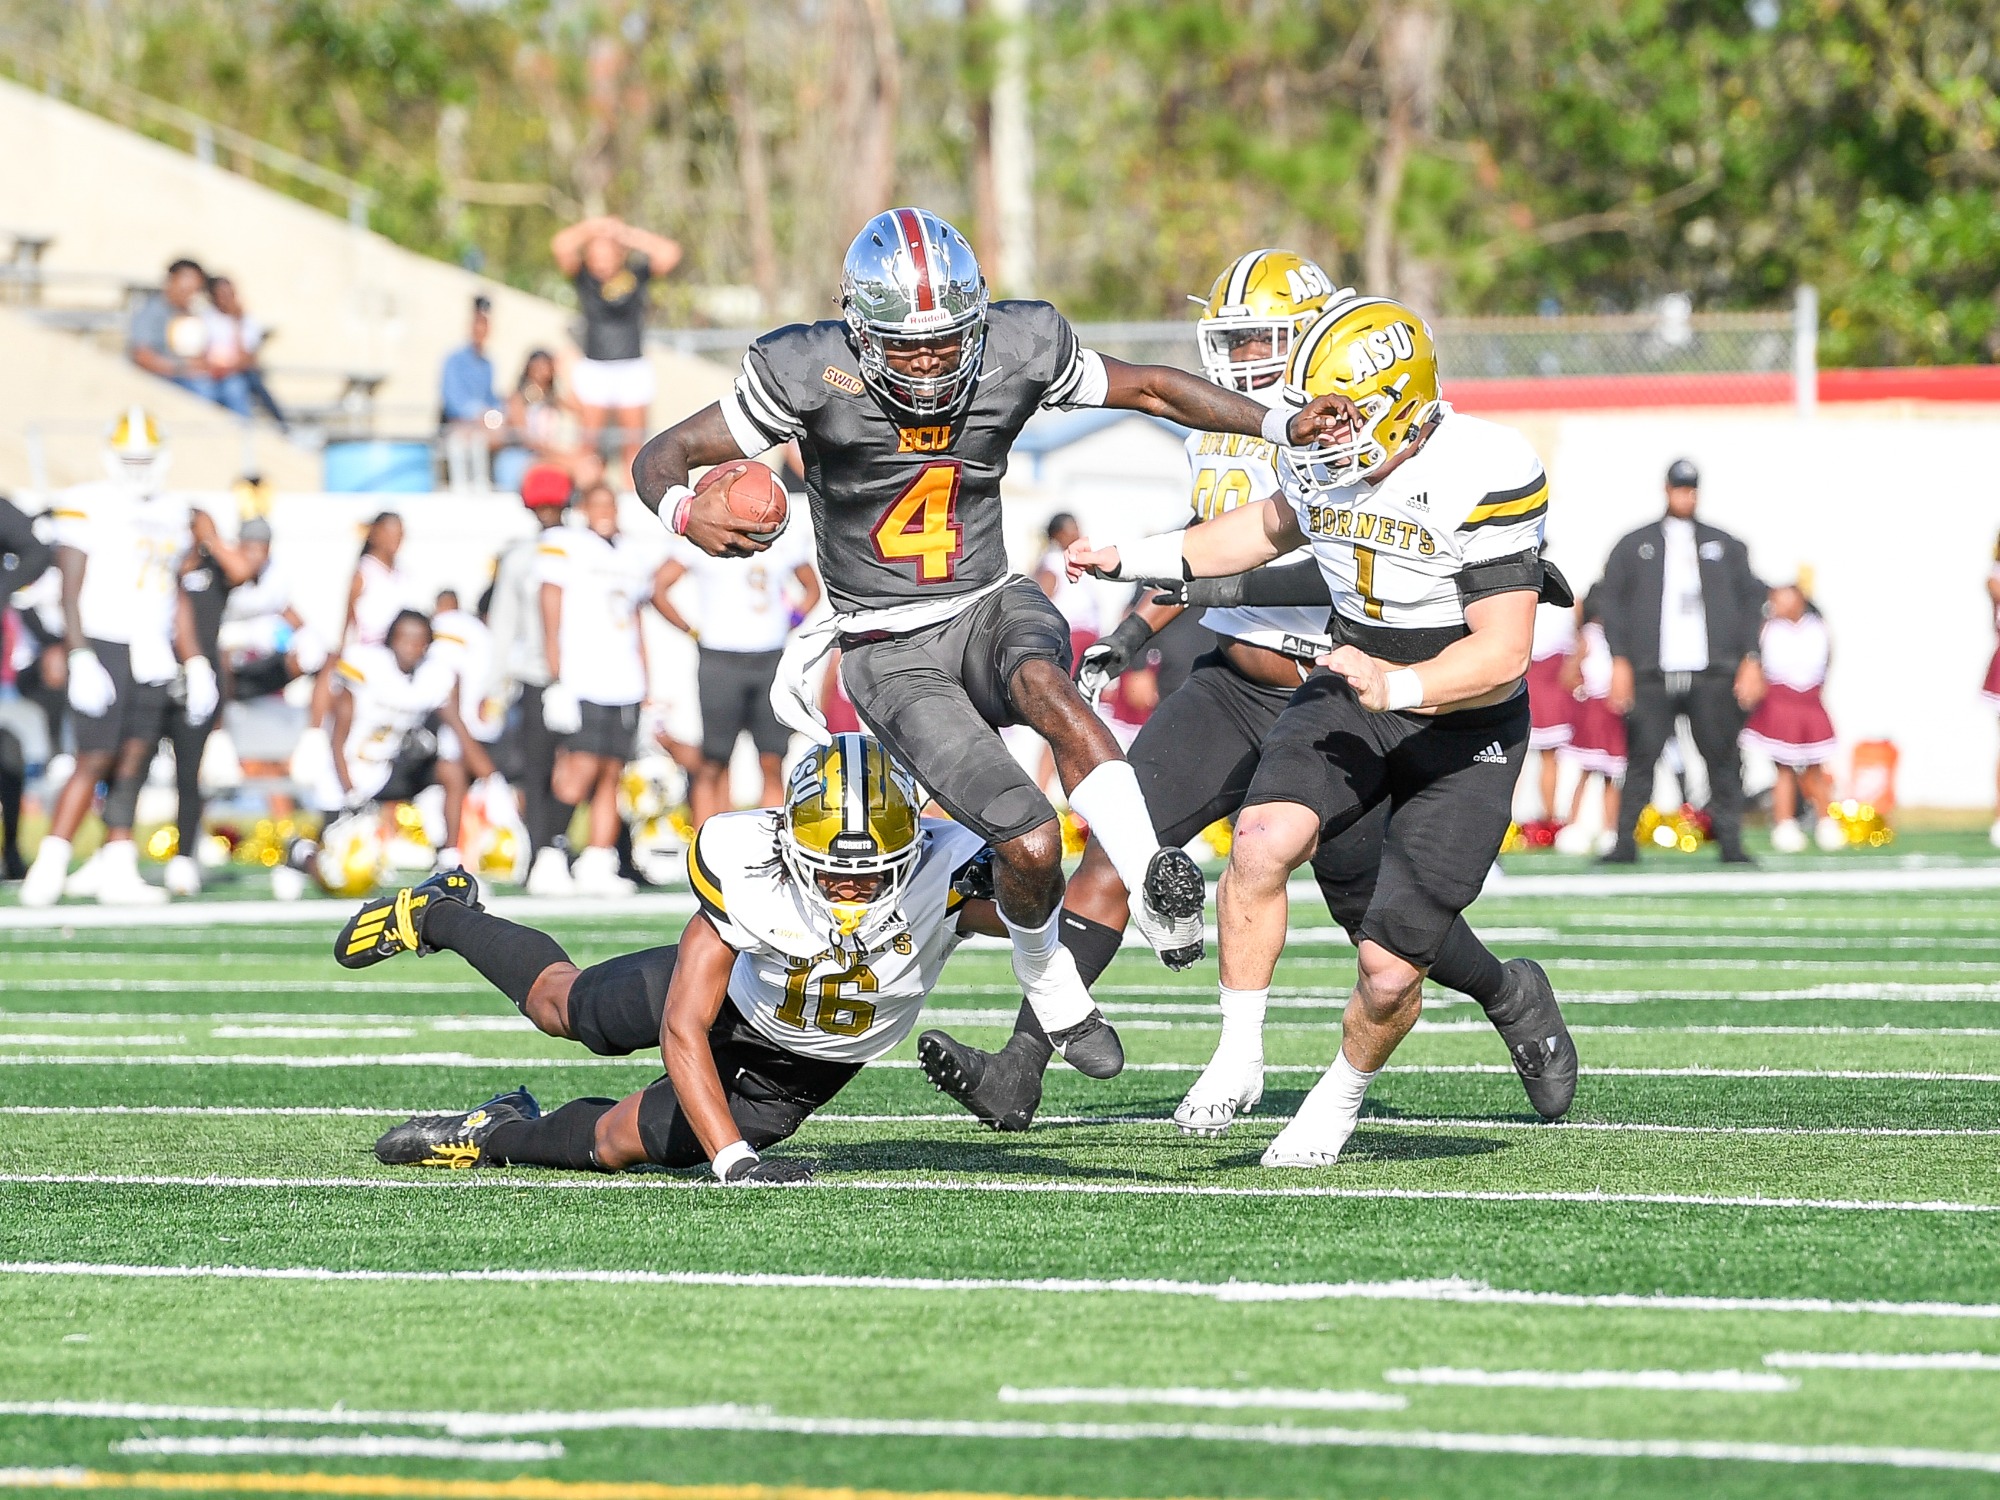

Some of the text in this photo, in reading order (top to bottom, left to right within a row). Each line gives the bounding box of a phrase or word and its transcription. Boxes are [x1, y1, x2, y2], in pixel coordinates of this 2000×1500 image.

[1285, 264, 1332, 304] ASU
[910, 311, 946, 324] Riddell
[1348, 321, 1414, 385] ASU
[825, 368, 861, 393] SWAC
[897, 425, 951, 453] BCU
[869, 460, 963, 586] 4
[1307, 504, 1435, 555] HORNETS
[1353, 543, 1384, 621] 1
[1472, 754, 1508, 765] adidas
[878, 921, 911, 933] adidas
[773, 964, 879, 1038] 16
